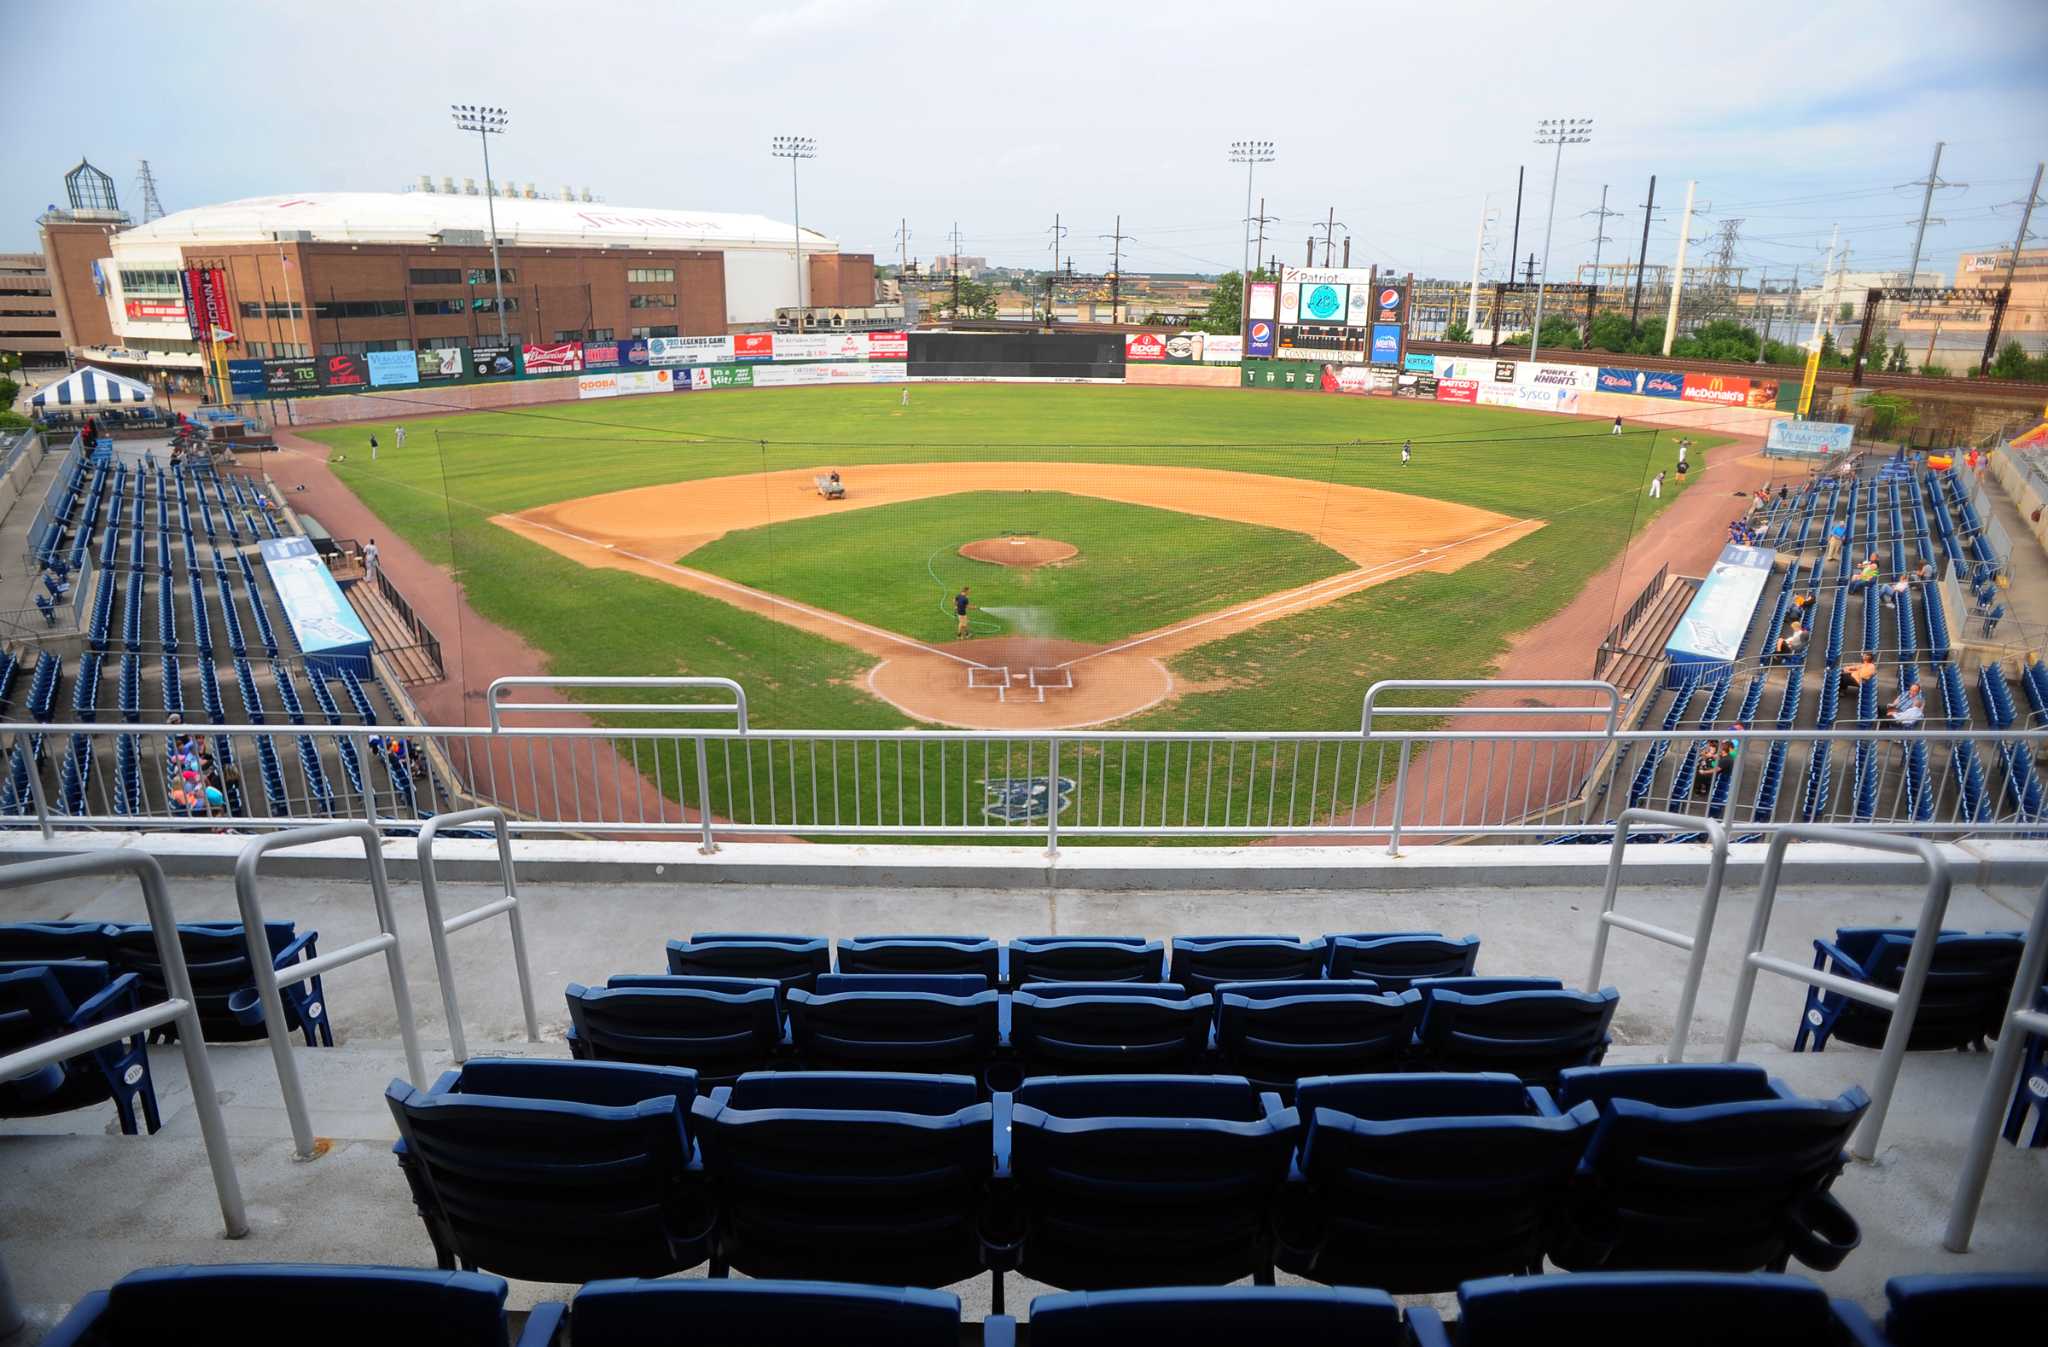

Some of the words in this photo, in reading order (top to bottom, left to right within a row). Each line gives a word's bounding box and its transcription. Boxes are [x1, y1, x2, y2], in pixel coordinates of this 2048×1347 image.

[1976, 255, 1996, 266] PSEG
[1300, 273, 1338, 284] Patriot
[528, 351, 568, 361] Budweiser
[1540, 368, 1577, 378] PURPLE
[1534, 374, 1579, 387] KNIGHTS
[1519, 386, 1551, 401] Sysco
[1684, 387, 1745, 402] McDonald's
